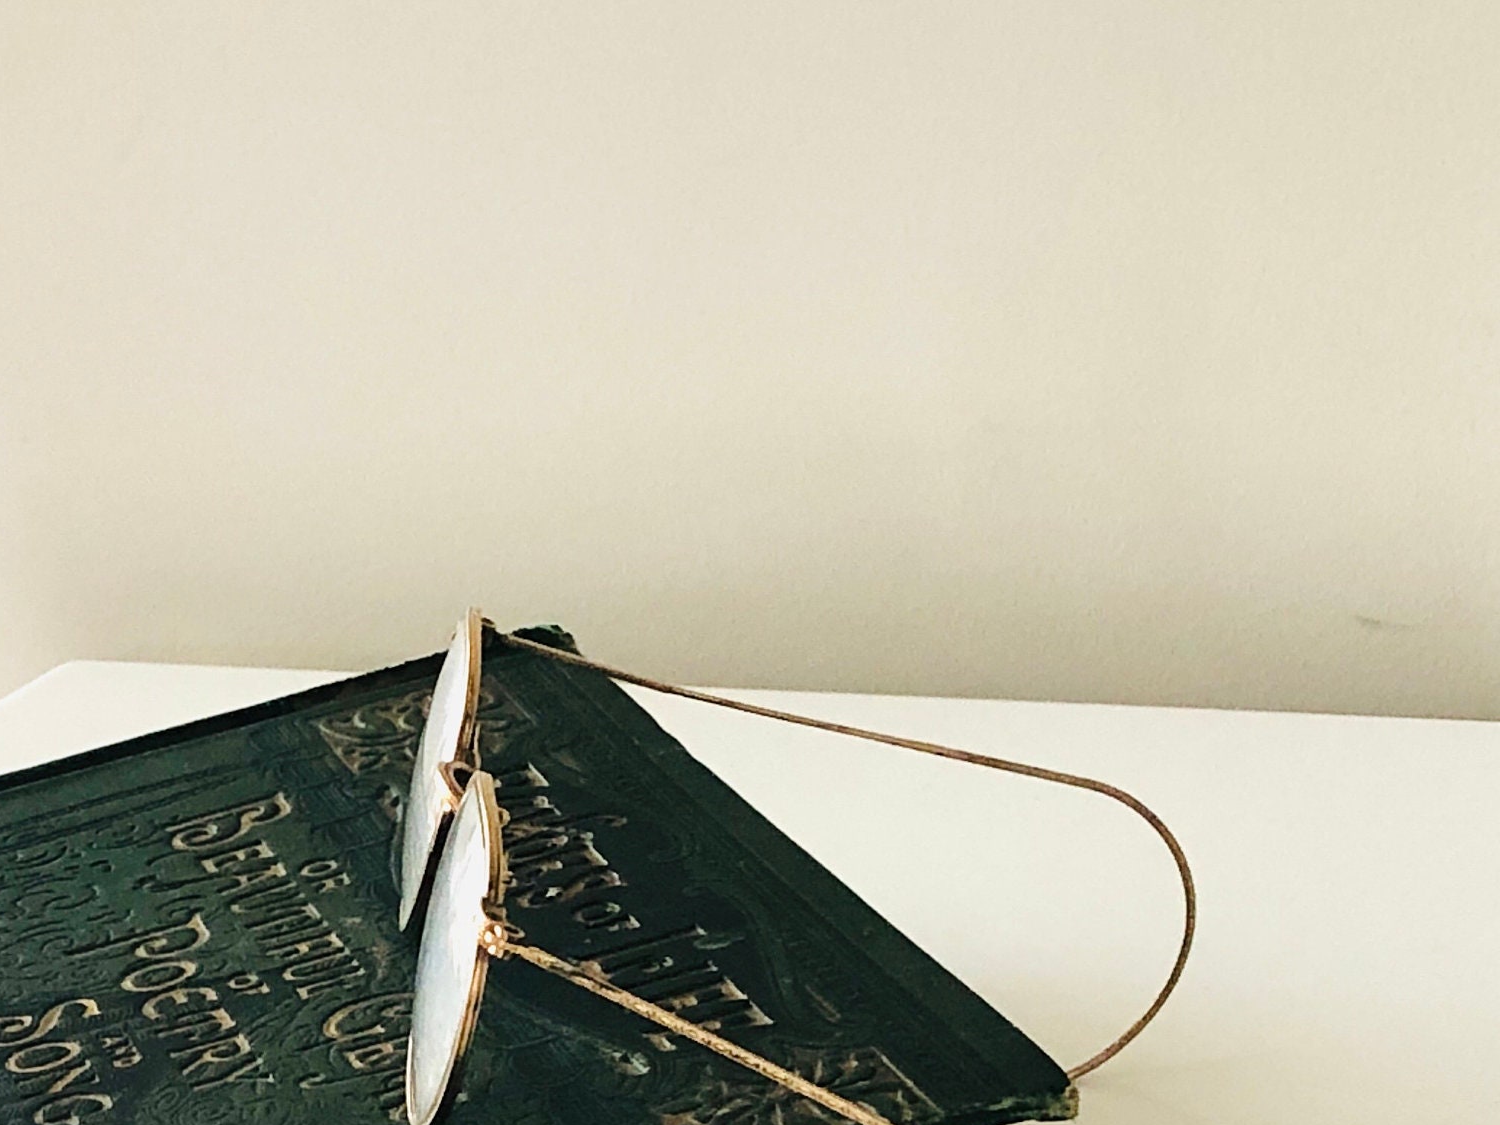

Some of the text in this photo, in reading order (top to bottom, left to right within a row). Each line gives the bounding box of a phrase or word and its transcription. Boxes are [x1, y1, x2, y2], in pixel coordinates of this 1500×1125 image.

[299, 857, 352, 895] OR
[136, 791, 435, 1122] BEAUTIFUL GE
[64, 912, 276, 1092] POETRY
[227, 972, 271, 997] OF
[102, 1036, 144, 1070] AND
